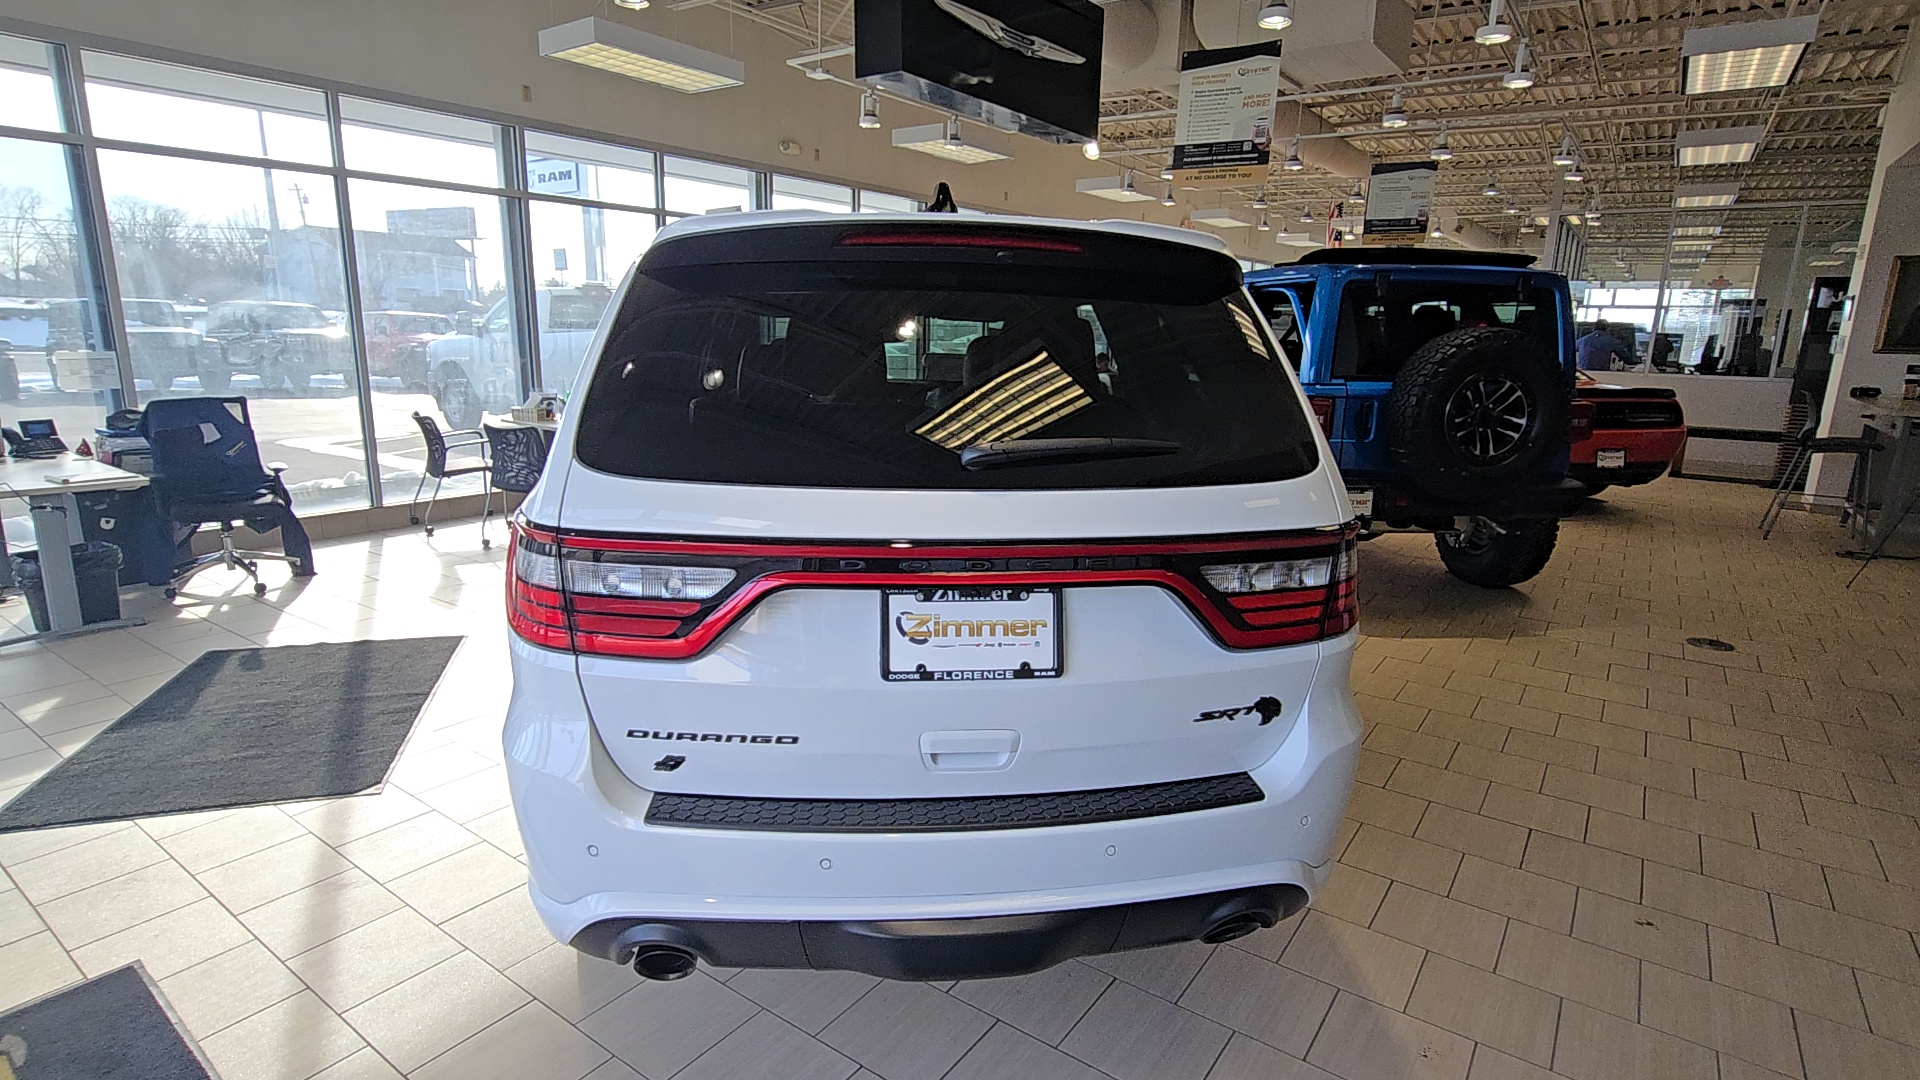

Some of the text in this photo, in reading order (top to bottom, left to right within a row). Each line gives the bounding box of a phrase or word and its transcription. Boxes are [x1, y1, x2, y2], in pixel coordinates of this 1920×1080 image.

[1242, 99, 1271, 109] MORE!
[537, 169, 573, 184] RAM
[904, 613, 1048, 639] Zimmer
[934, 670, 1015, 681] FLORENCE
[1192, 705, 1256, 723] SRT
[626, 729, 800, 745] DURANGO
